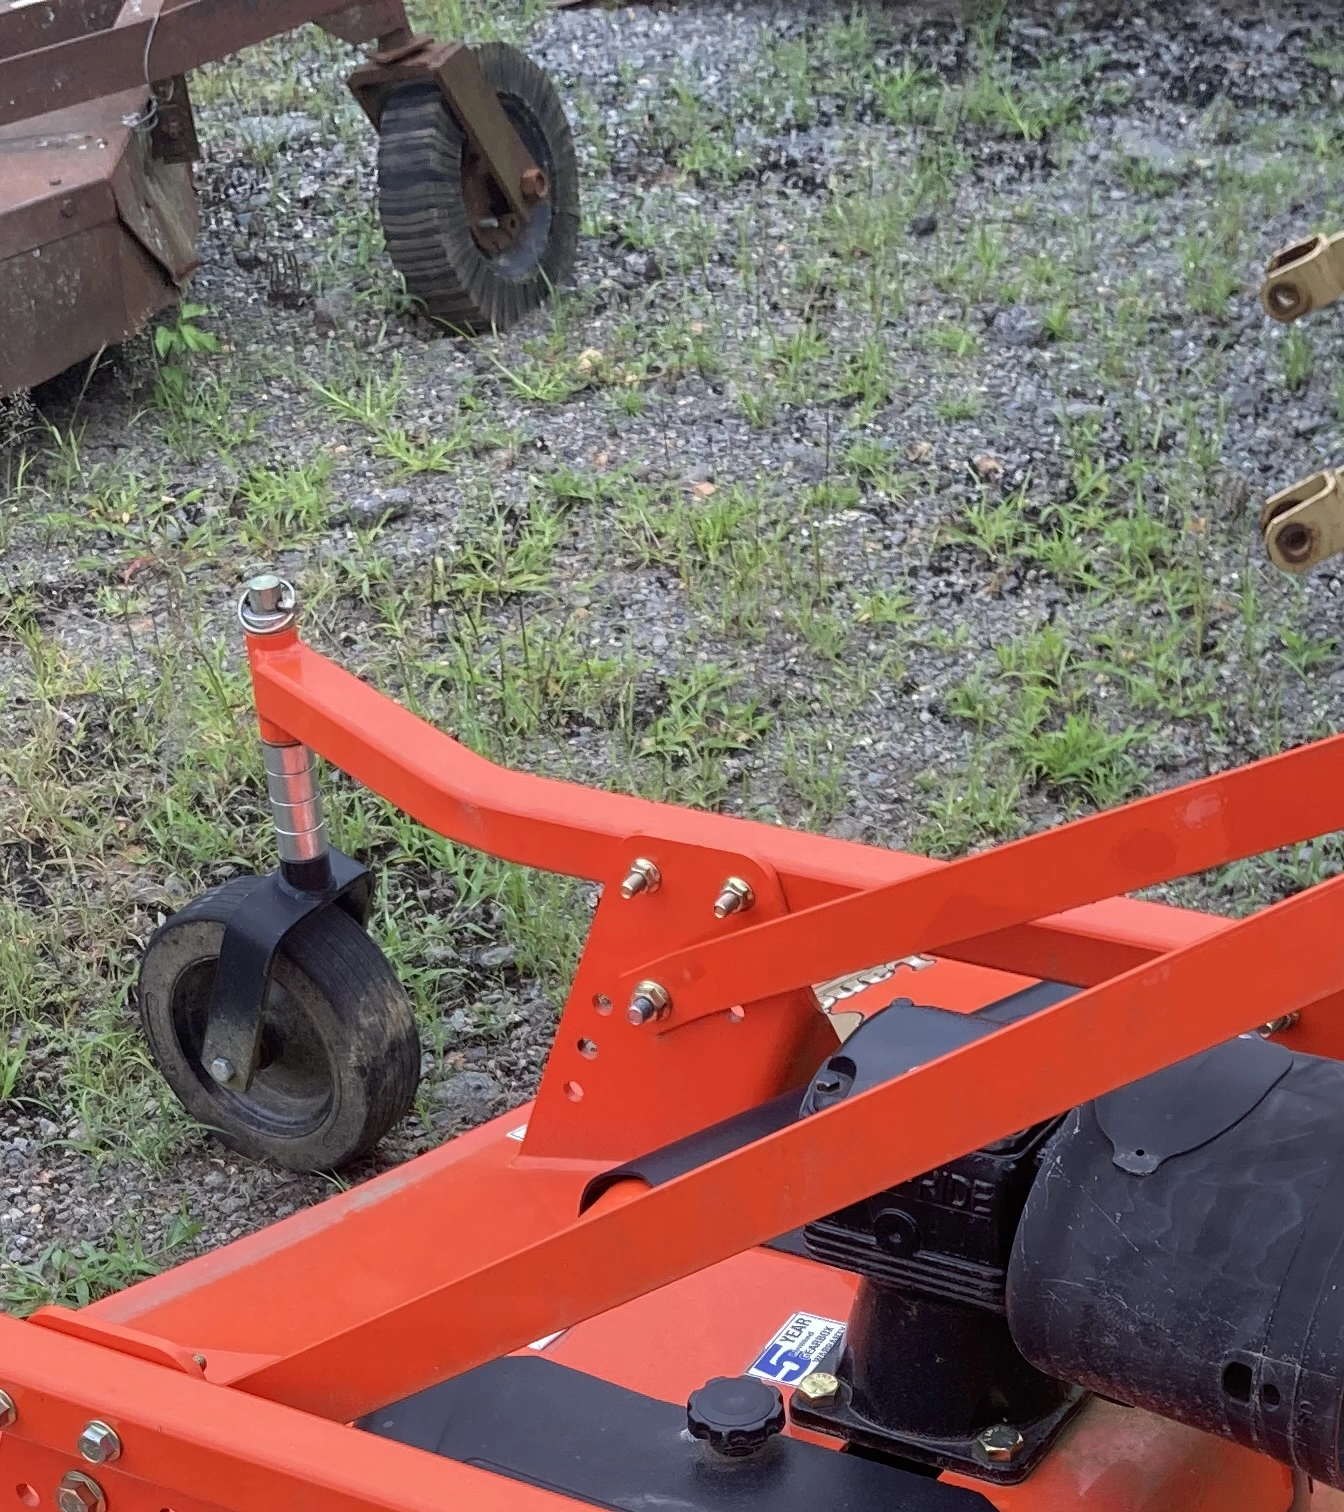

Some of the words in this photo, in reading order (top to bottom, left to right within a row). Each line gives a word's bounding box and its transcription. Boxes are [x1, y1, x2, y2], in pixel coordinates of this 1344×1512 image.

[780, 1318, 812, 1343] YEAR
[798, 1325, 835, 1360] GEARBOX
[753, 1343, 811, 1381] 5
